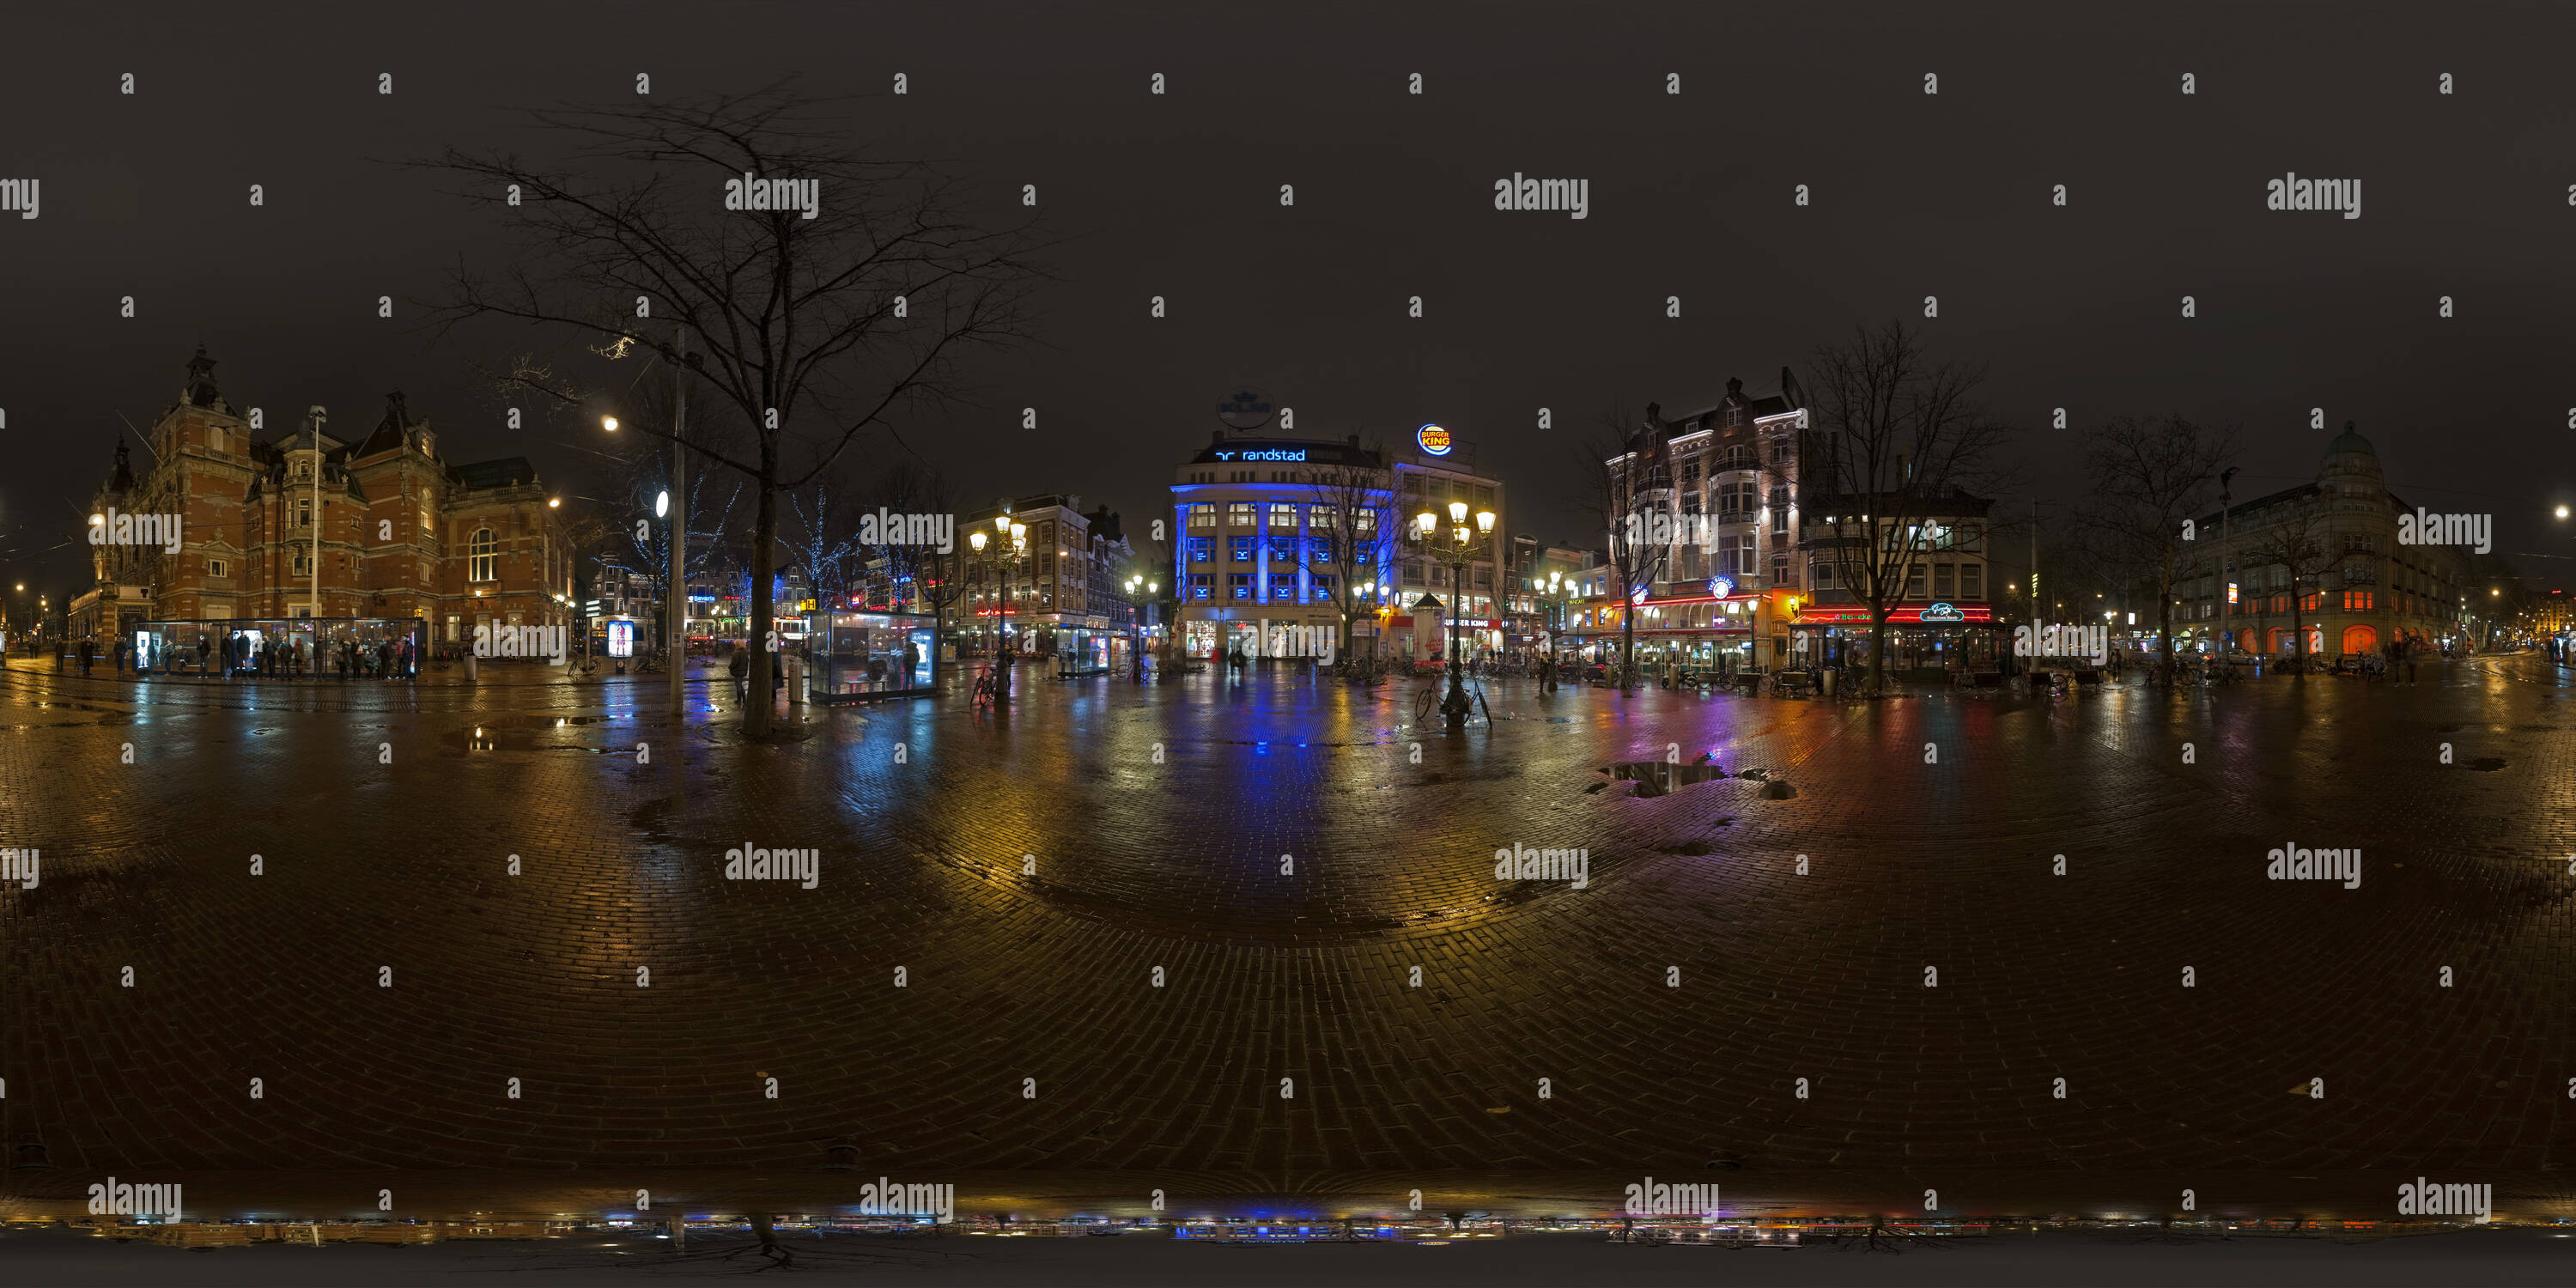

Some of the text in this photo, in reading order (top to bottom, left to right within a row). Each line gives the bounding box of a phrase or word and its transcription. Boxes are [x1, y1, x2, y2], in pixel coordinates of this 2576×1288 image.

[1422, 437, 1450, 447] KING
[1242, 448, 1306, 462] randstad
[1714, 576, 1735, 590] BULLDOG
[1471, 619, 1489, 628] KING
